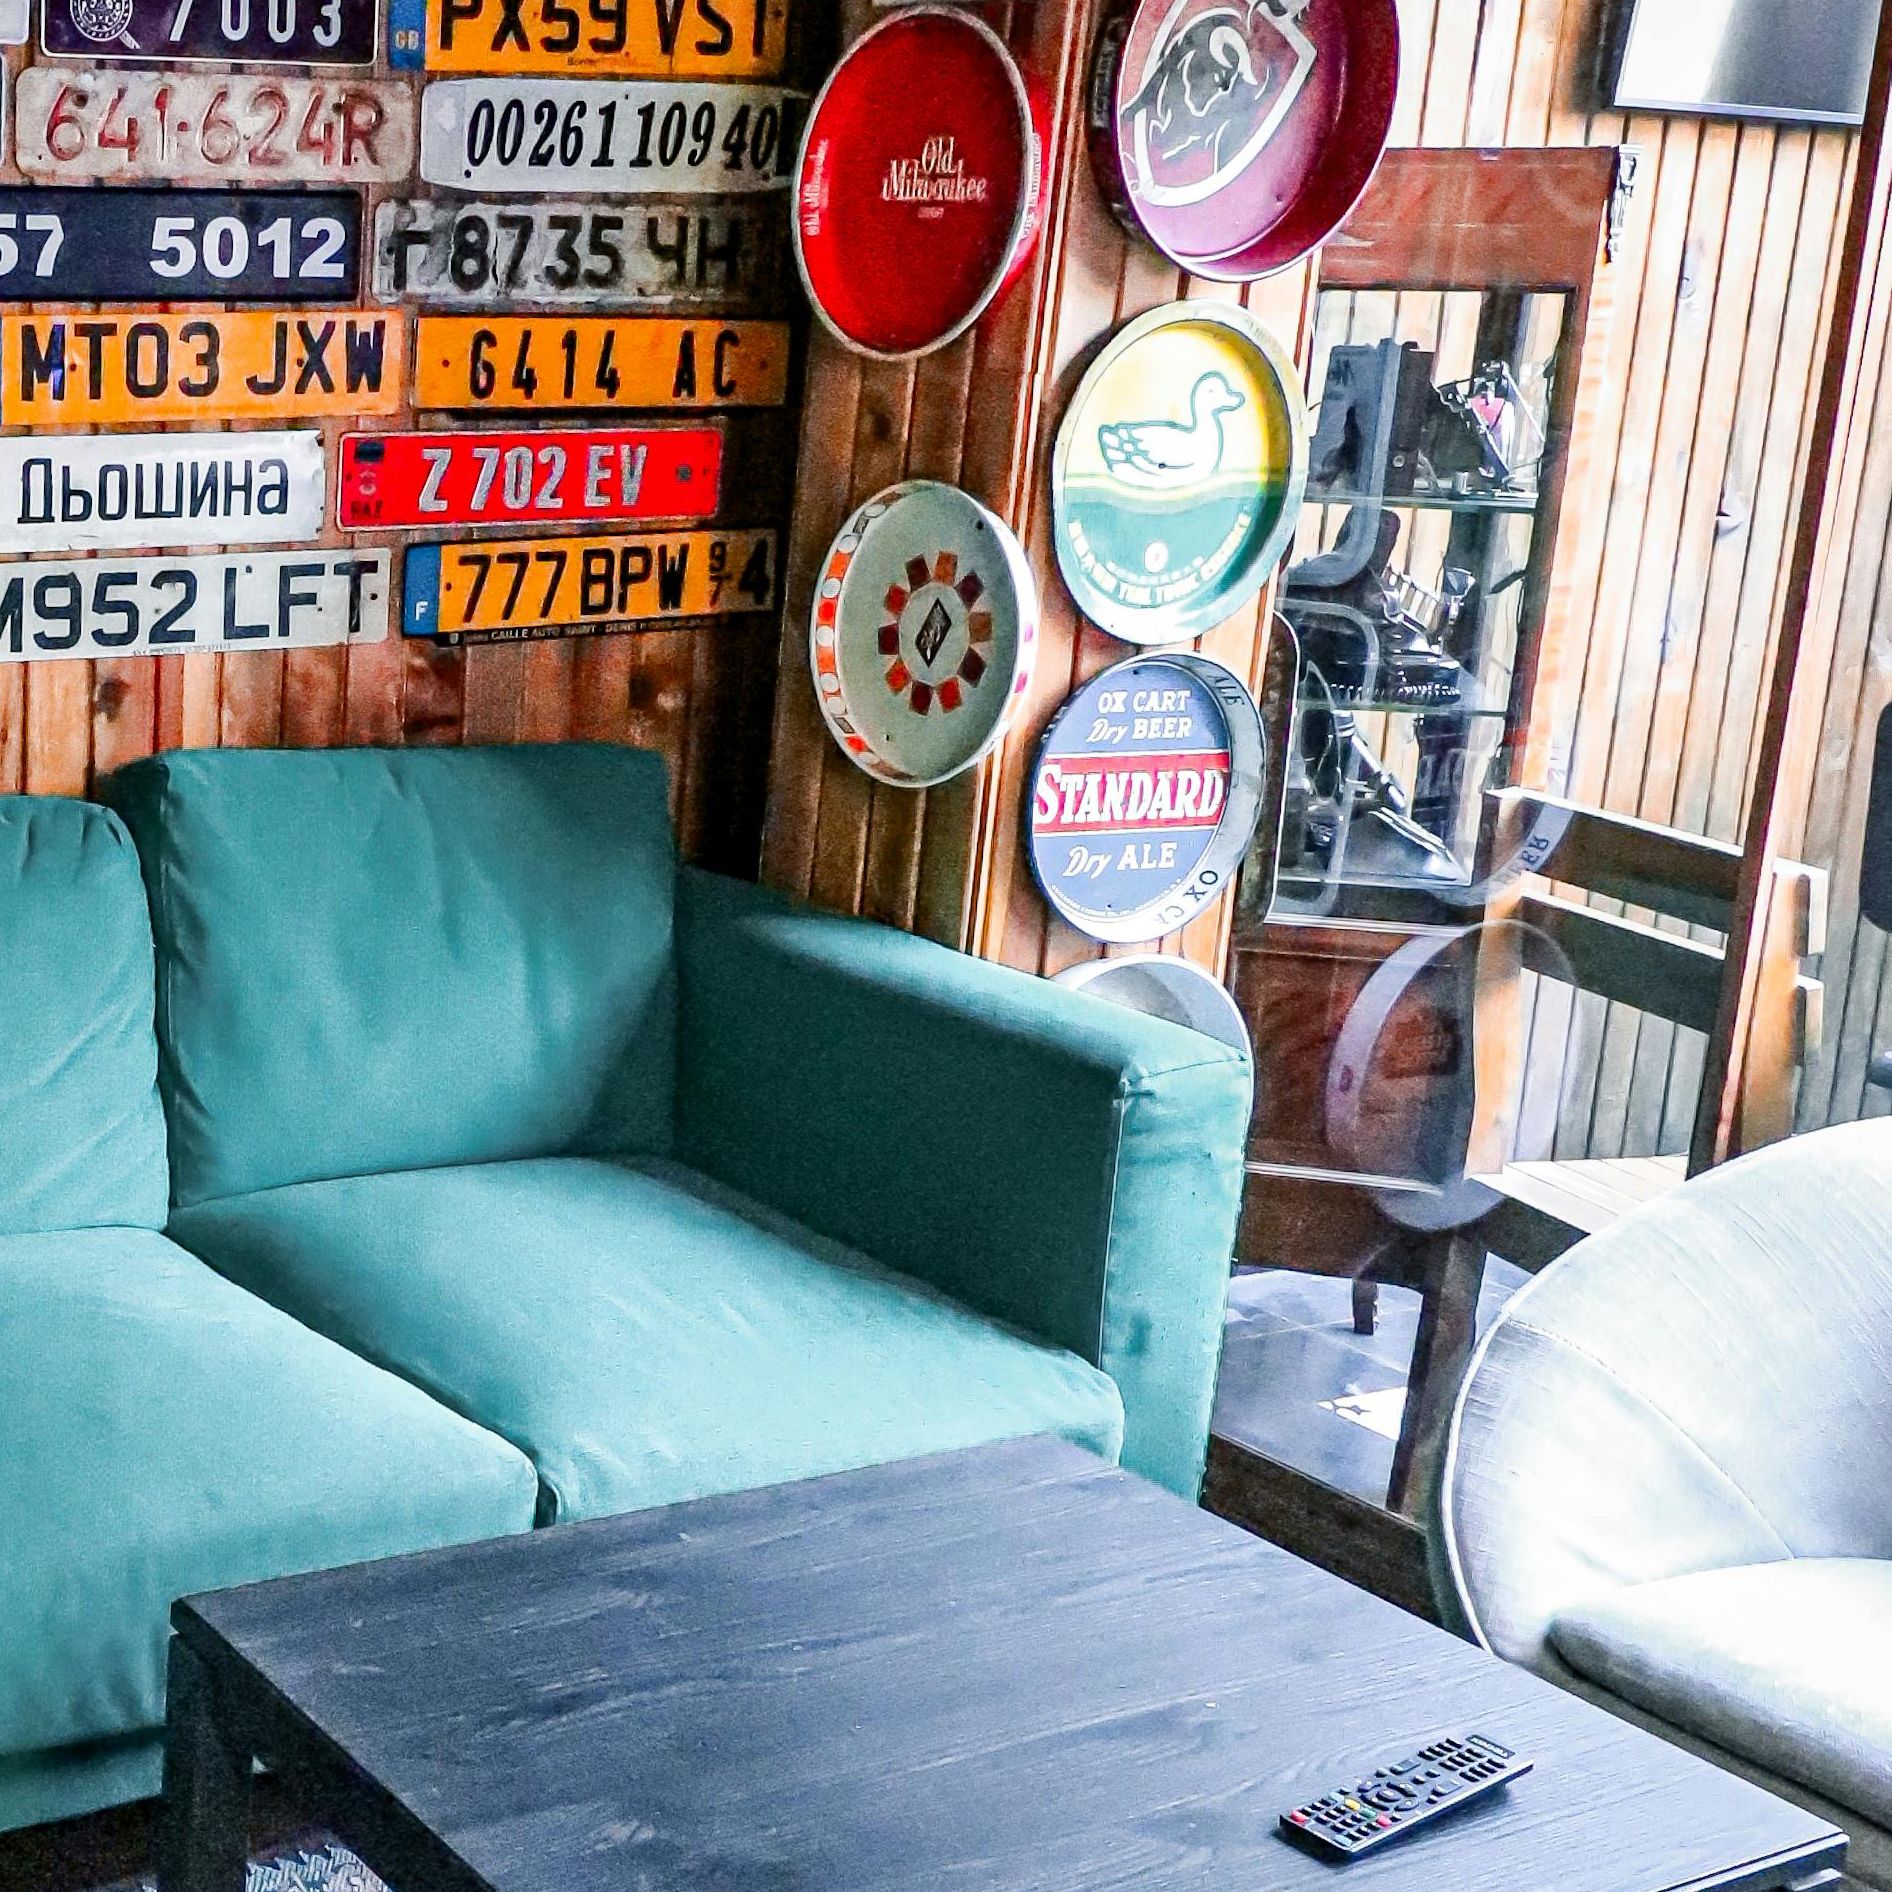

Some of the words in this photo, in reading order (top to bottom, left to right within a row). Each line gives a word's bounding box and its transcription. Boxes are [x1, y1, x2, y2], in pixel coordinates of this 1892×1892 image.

[881, 158, 988, 204] Milwaukee
[921, 135, 956, 178] Old
[149, 217, 346, 279] 5012
[450, 215, 624, 291] 8735
[21, 322, 221, 401] MT03
[246, 319, 385, 395] JXW
[470, 329, 620, 400] 6414
[673, 329, 740, 399] AC
[18, 457, 289, 525] Дьошина
[418, 447, 452, 512] Z
[471, 446, 567, 511] 702
[584, 444, 648, 508] EV
[223, 561, 380, 640] LFT
[415, 601, 429, 621] F
[457, 551, 568, 624] 777
[580, 544, 689, 617] BPW
[1085, 717, 1128, 744] Dry
[1132, 716, 1193, 740] BEER
[1098, 691, 1127, 714] OX
[1133, 689, 1190, 712] CART
[1034, 763, 1225, 825] STANDARD
[1062, 845, 1112, 880] Dry
[1116, 842, 1178, 871] ALE
